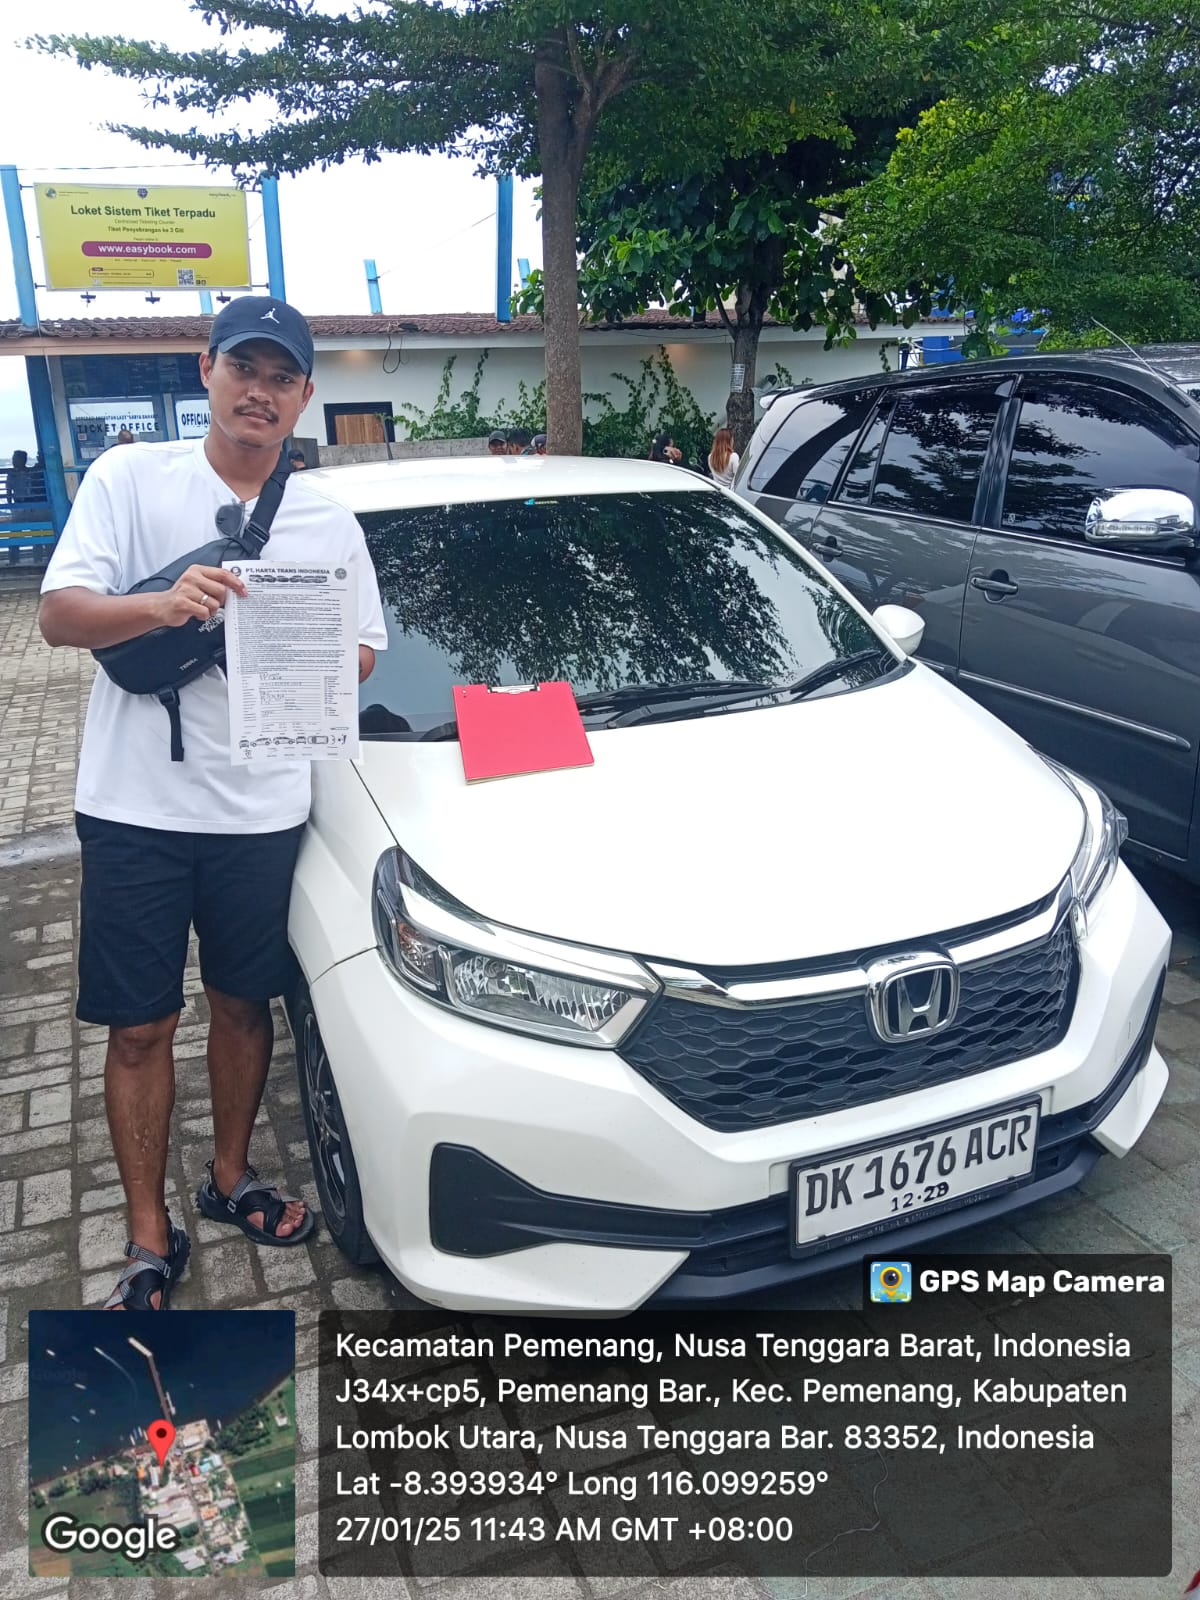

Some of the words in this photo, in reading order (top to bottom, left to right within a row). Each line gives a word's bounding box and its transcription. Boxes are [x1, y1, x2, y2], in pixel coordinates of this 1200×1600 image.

[71, 205, 102, 216] Loket
[104, 206, 142, 217] Sistem
[144, 207, 170, 217] Tiket
[173, 208, 216, 219] Terpadu
[98, 245, 197, 255] www.easybook.com
[77, 423, 117, 433] TICKET
[121, 422, 160, 432] OFFICE
[805, 1163, 855, 1217] DK
[863, 1136, 957, 1199] 1676
[964, 1115, 1032, 1169] ACR
